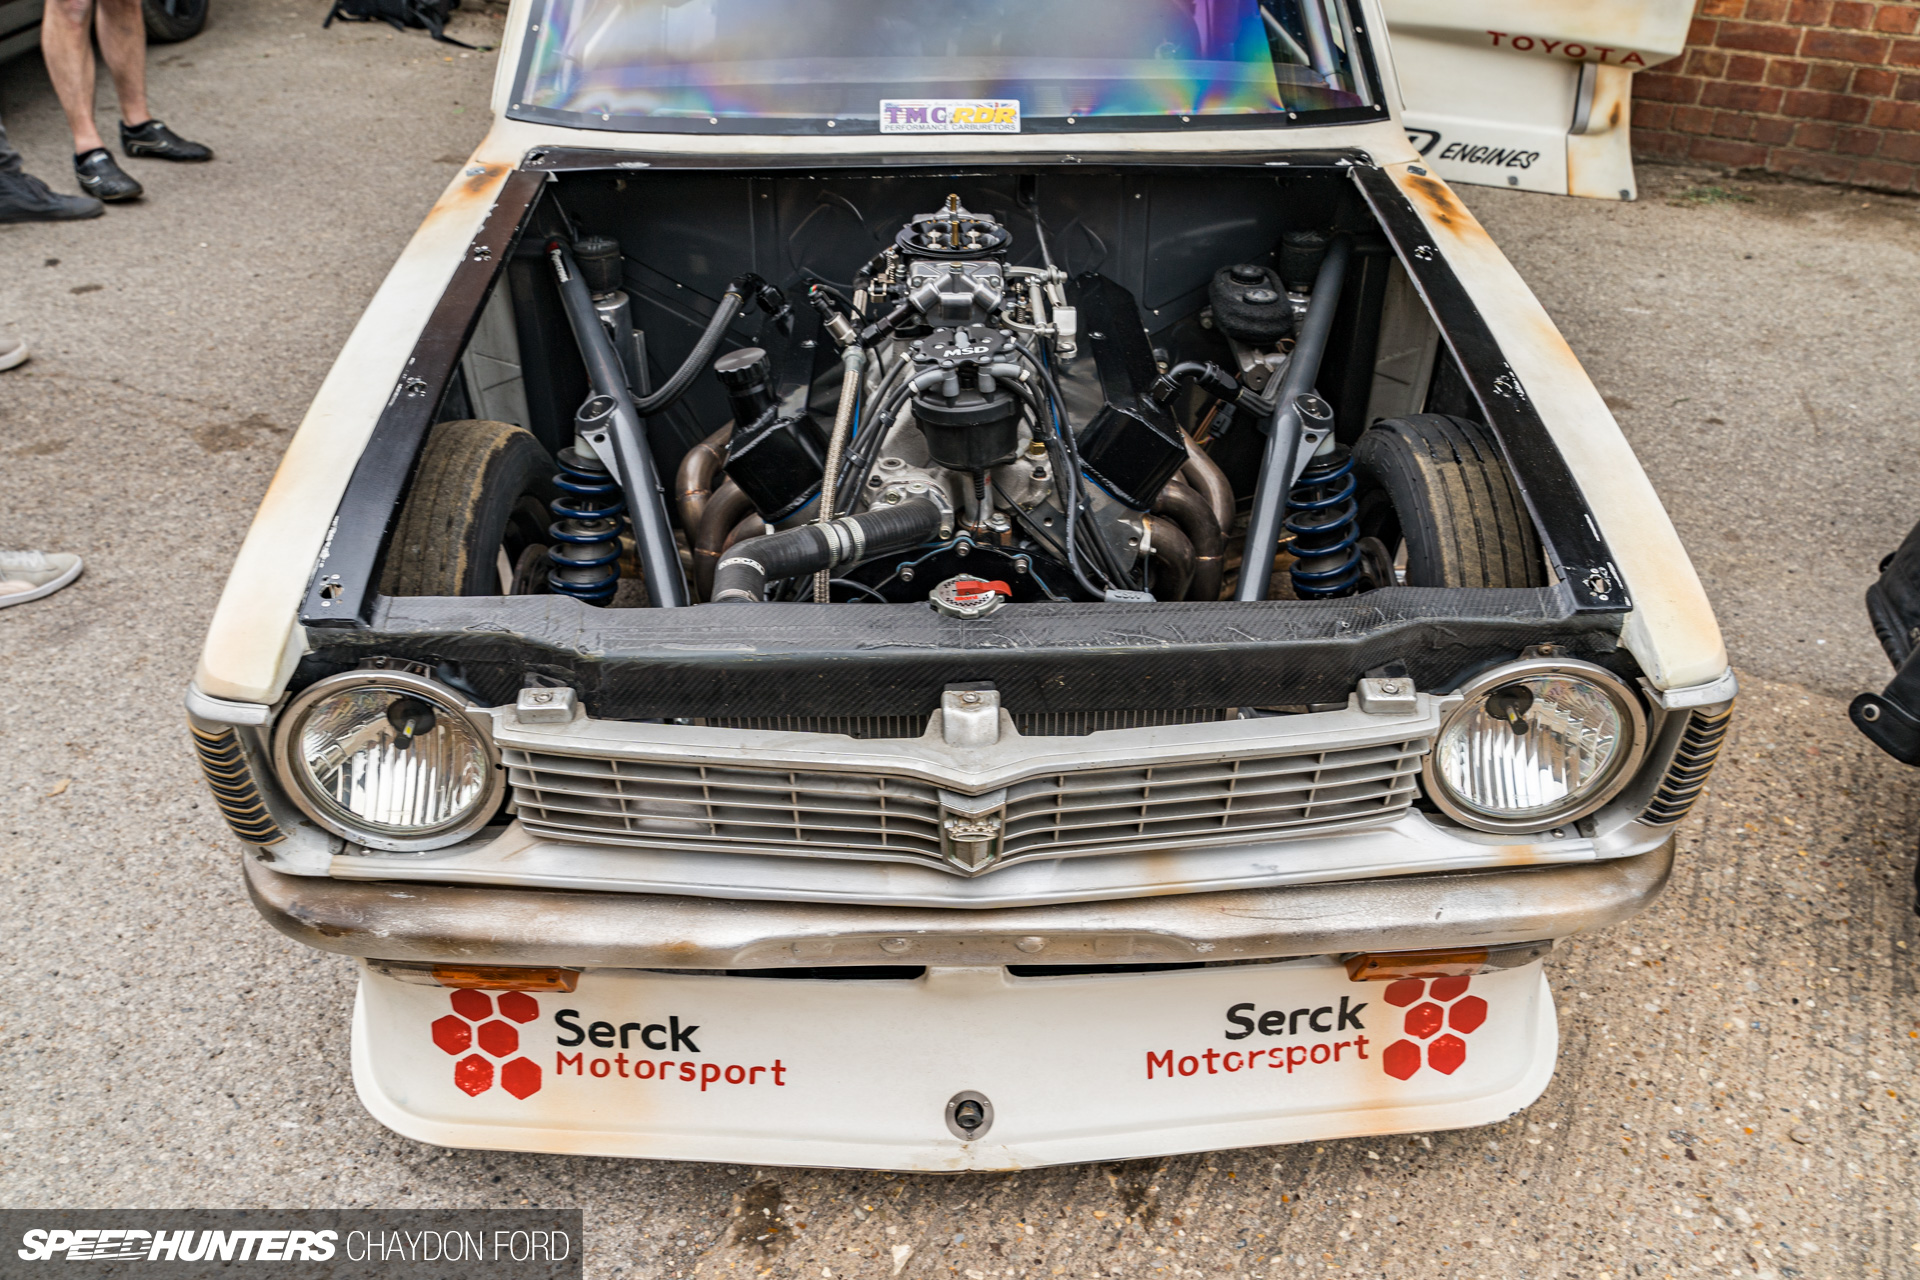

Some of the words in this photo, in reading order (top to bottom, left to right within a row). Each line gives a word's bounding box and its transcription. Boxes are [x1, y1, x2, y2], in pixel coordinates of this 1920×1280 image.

[1486, 30, 1646, 66] TOYOTA
[885, 107, 947, 124] TMC
[952, 107, 1017, 124] RDR
[1438, 142, 1541, 169] ENGINES
[943, 346, 990, 358] MSD
[554, 1008, 702, 1052] Serck
[1224, 995, 1369, 1040] Serck
[556, 1050, 787, 1092] Motorsport
[1146, 1034, 1370, 1080] Motorsport
